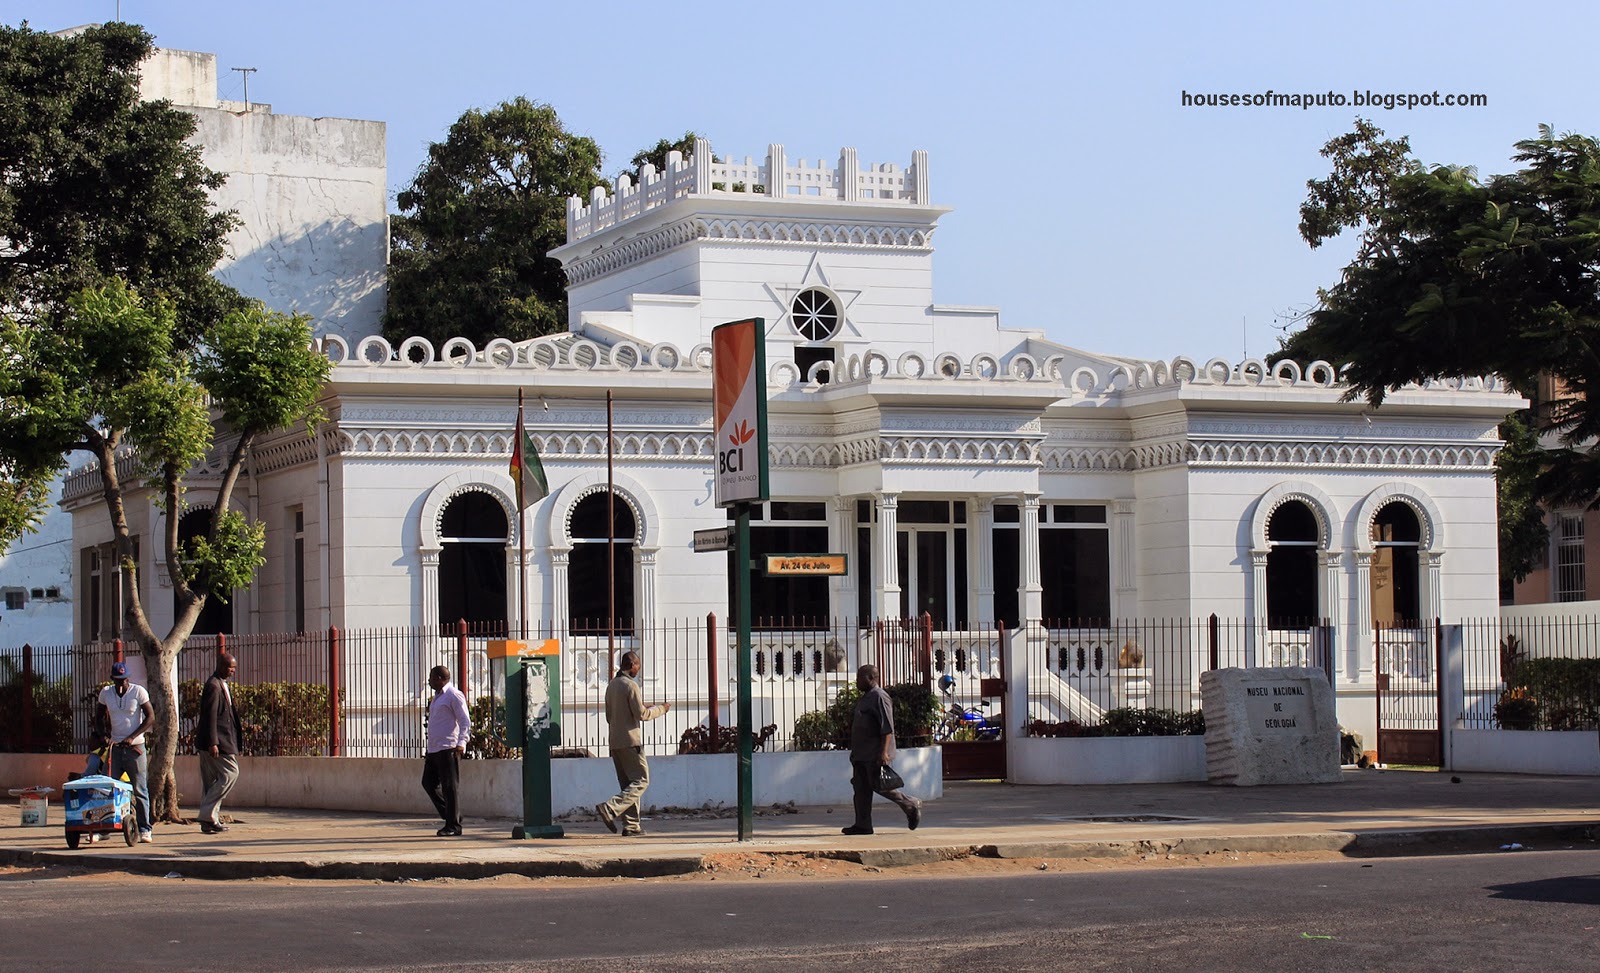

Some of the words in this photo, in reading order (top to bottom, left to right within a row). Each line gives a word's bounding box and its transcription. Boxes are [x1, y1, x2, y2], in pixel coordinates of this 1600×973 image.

[719, 448, 744, 475] BCI
[780, 561, 791, 570] Av.
[792, 561, 800, 570] 24
[802, 561, 811, 570] de
[812, 561, 831, 570] Julho
[1246, 687, 1269, 697] MUSEU
[1272, 686, 1305, 696] NACIONAL
[1273, 702, 1282, 712] DE
